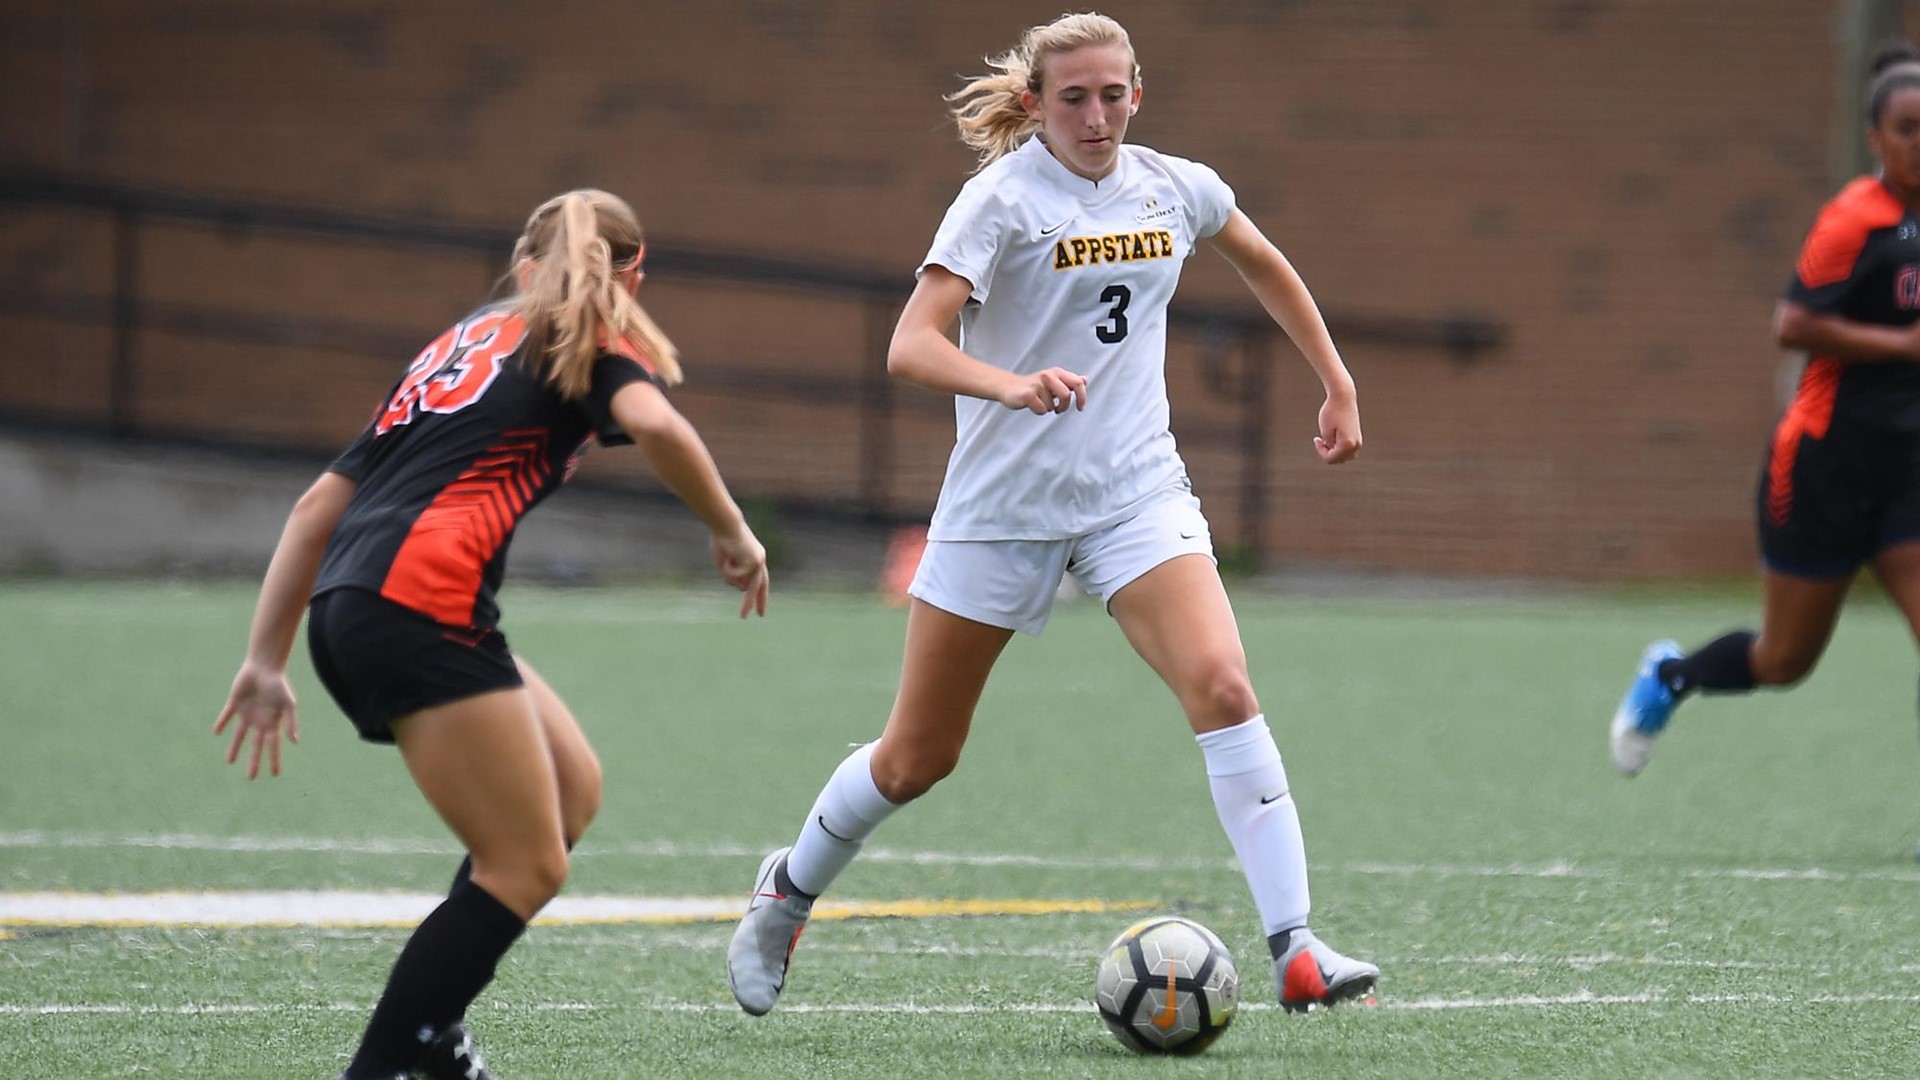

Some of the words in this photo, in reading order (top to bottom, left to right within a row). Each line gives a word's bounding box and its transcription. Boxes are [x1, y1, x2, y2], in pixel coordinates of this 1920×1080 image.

[1054, 231, 1173, 270] APPSTATE
[1096, 284, 1131, 344] 3
[374, 311, 528, 437] 23
